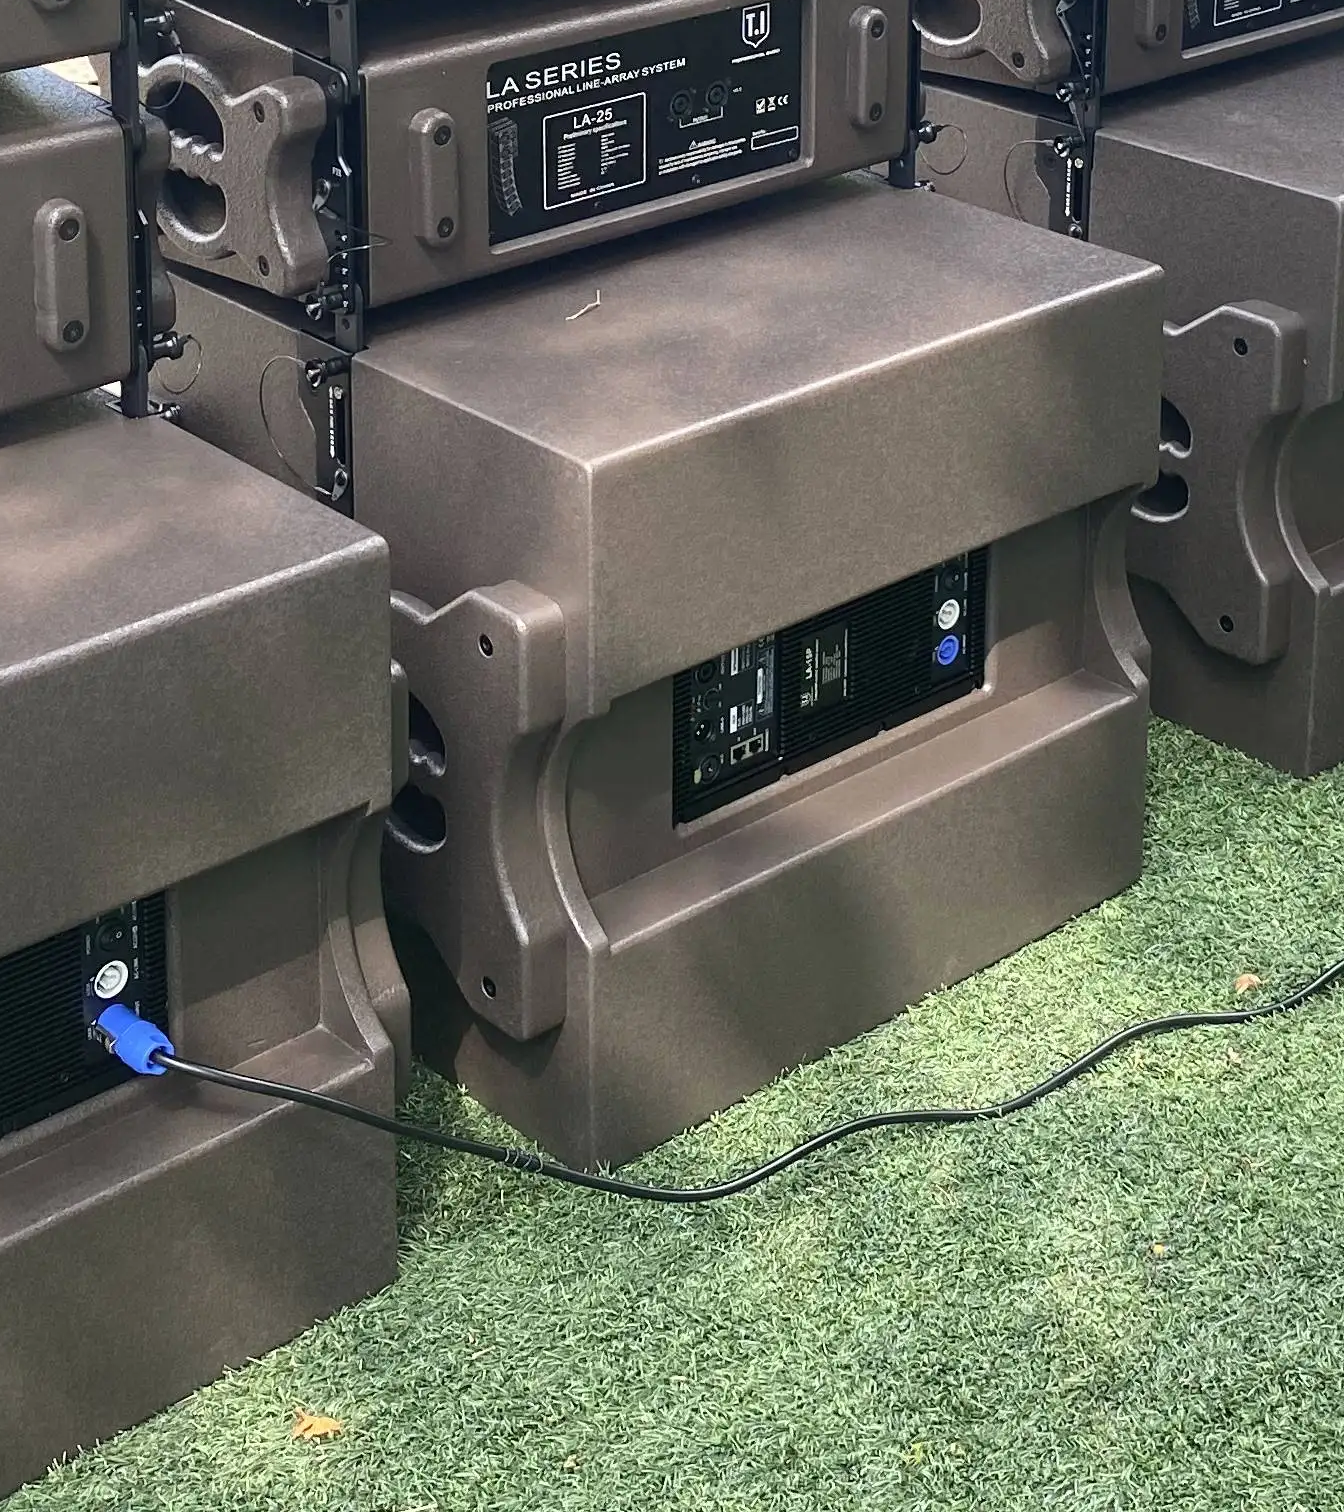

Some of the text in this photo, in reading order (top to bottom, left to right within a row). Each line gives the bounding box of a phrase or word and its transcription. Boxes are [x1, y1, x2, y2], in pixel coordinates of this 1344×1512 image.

[486, 51, 622, 100] LA SERIES
[487, 57, 686, 115] PROFESSIONAL LINE-ARRAY SYSTEM
[573, 107, 614, 130] LA-25
